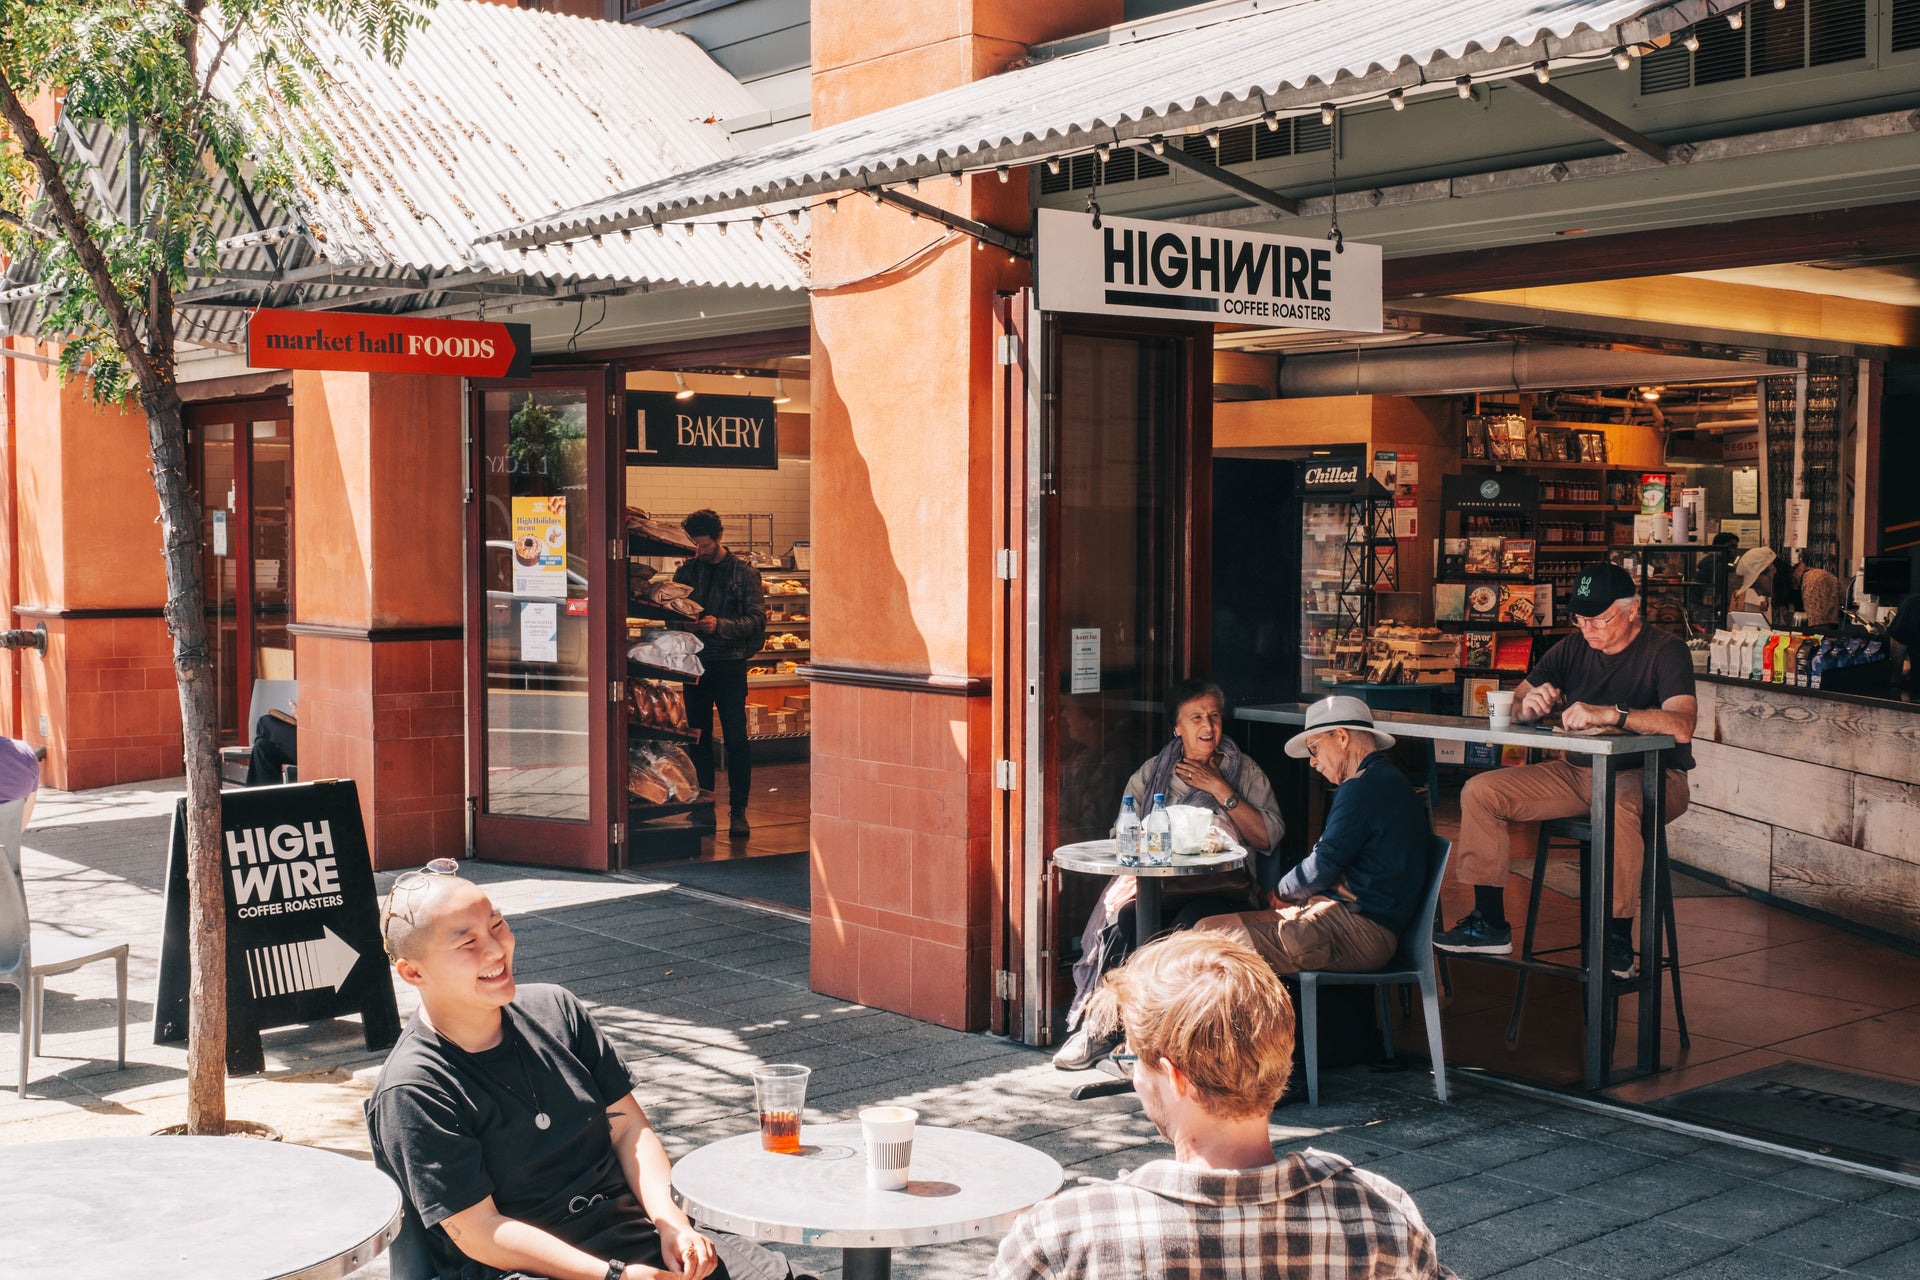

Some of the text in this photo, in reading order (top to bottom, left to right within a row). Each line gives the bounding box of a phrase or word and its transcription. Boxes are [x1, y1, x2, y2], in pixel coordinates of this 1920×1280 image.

[1104, 227, 1332, 302] HIGHWIRE
[1224, 299, 1331, 321] COFFEE ROASTERS
[266, 329, 495, 359] market hall FOODS
[626, 410, 764, 453] L BAKERY
[1305, 466, 1358, 484] Chilled
[516, 517, 561, 525] High Holidays
[1466, 633, 1491, 642] Flavor
[225, 820, 335, 866] HIGH
[231, 857, 342, 905] WIRE
[238, 895, 343, 919] COFFEE ROASTERS
